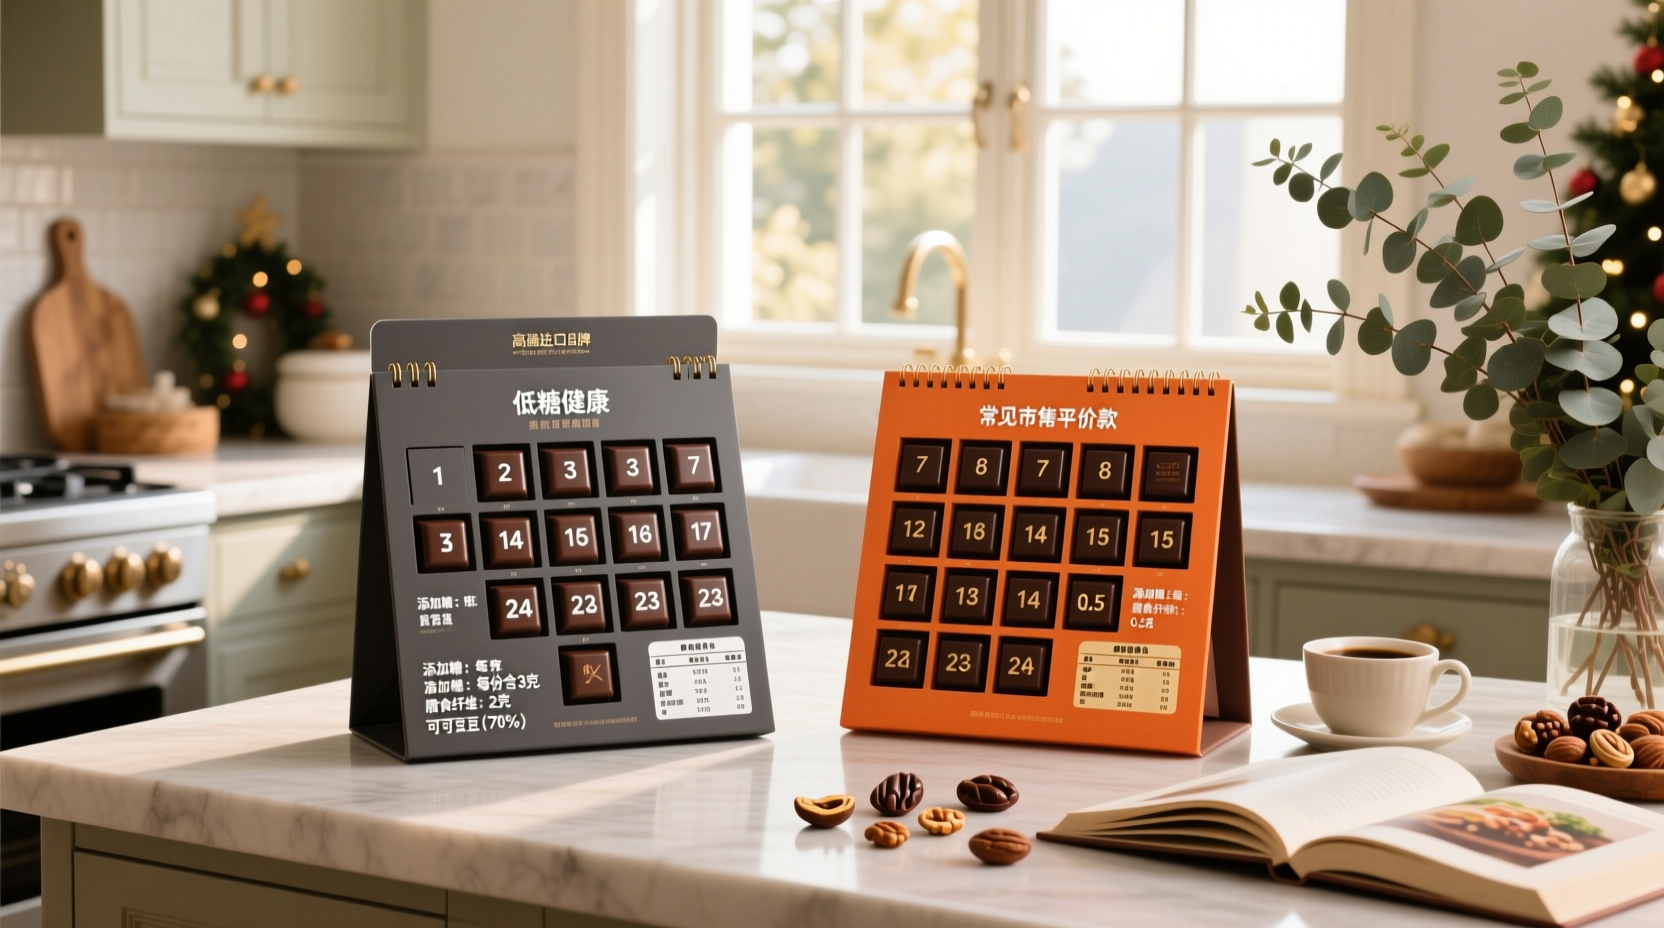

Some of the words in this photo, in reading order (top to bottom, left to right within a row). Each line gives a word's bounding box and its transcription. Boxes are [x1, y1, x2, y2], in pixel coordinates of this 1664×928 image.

[512, 388, 610, 416] 低糖健康
[432, 466, 443, 486] 1
[498, 463, 512, 482] 2
[563, 461, 577, 480] 3
[626, 458, 640, 477] 3
[687, 455, 700, 475] 7
[916, 455, 929, 474] 7
[975, 457, 988, 475] 8
[1036, 459, 1050, 478] 7
[1098, 461, 1112, 480] 8
[439, 532, 453, 552] 3
[498, 530, 524, 550] 14
[564, 527, 589, 547] 15
[628, 524, 652, 544] 16
[690, 521, 712, 541] 17
[903, 519, 926, 539] 12
[1024, 525, 1048, 544] 14
[1086, 527, 1110, 546] 15
[1150, 530, 1174, 549] 15
[505, 598, 534, 619] 24
[634, 591, 660, 611] 23
[956, 587, 979, 606] 13
[1017, 590, 1040, 609] 14
[1077, 593, 1106, 612] 0.5
